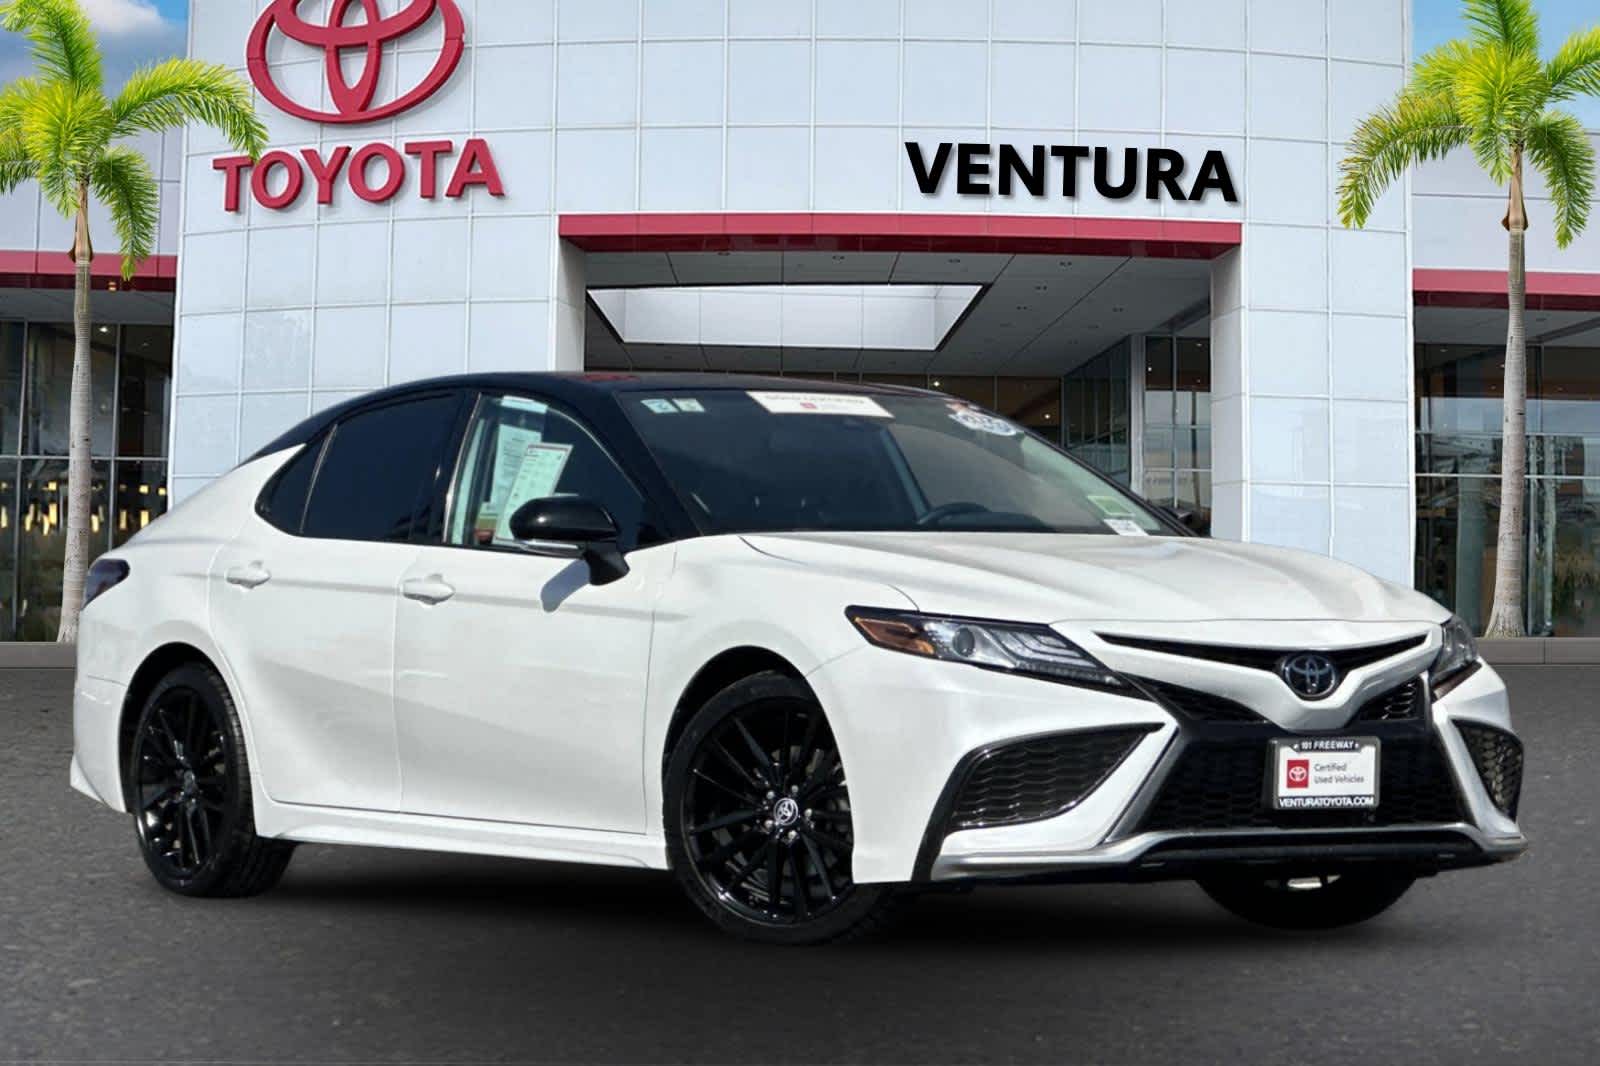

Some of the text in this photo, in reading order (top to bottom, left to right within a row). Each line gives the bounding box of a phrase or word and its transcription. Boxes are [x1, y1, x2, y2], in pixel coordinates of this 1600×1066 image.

[213, 139, 505, 212] TOYOTA
[904, 142, 1240, 202] VENTURA
[1301, 740, 1354, 749] 101 FREEWAY
[1314, 763, 1347, 772] Certified
[1314, 774, 1365, 784] Used Vehicles
[1279, 796, 1374, 807] VENTURATOYOTA.COM
